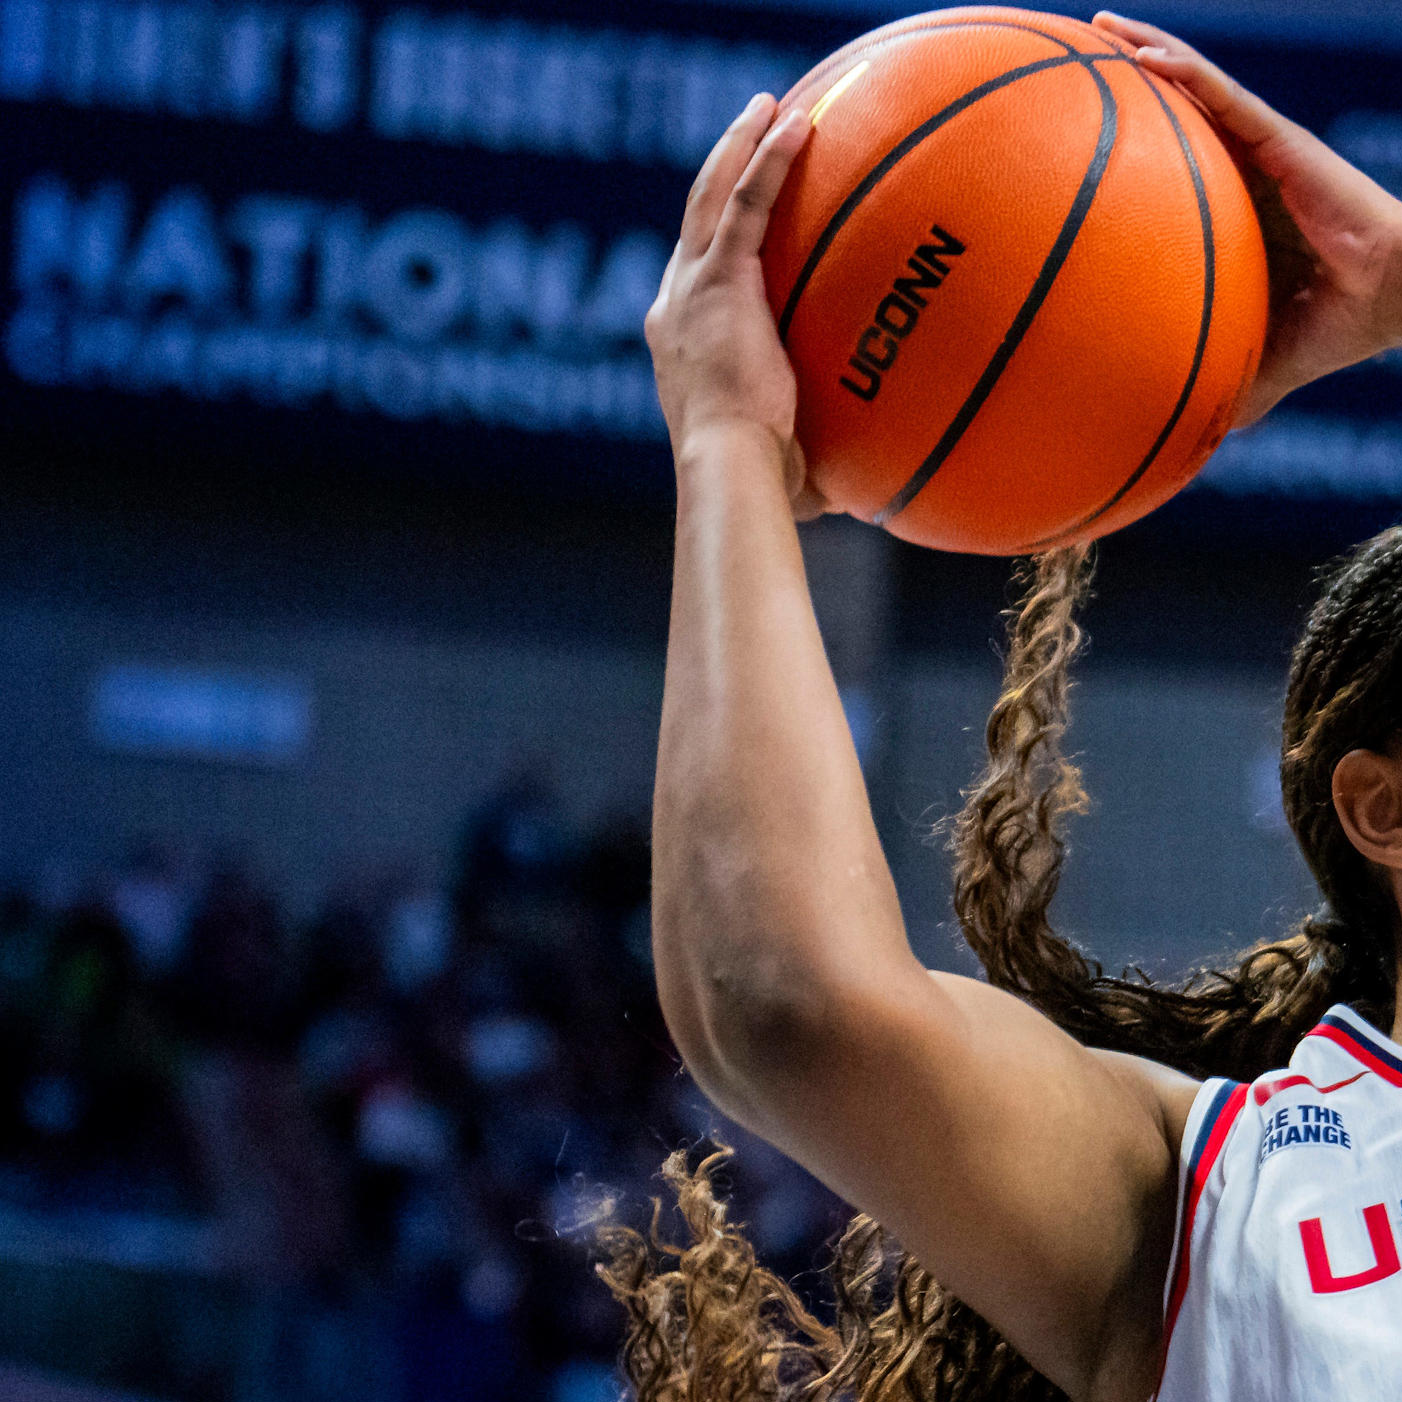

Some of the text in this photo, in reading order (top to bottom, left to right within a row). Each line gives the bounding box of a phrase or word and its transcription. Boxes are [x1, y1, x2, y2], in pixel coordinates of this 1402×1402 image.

[17, 173, 656, 344] NATIONA
[839, 224, 967, 402] UCONN
[1297, 1104, 1345, 1129] THE
